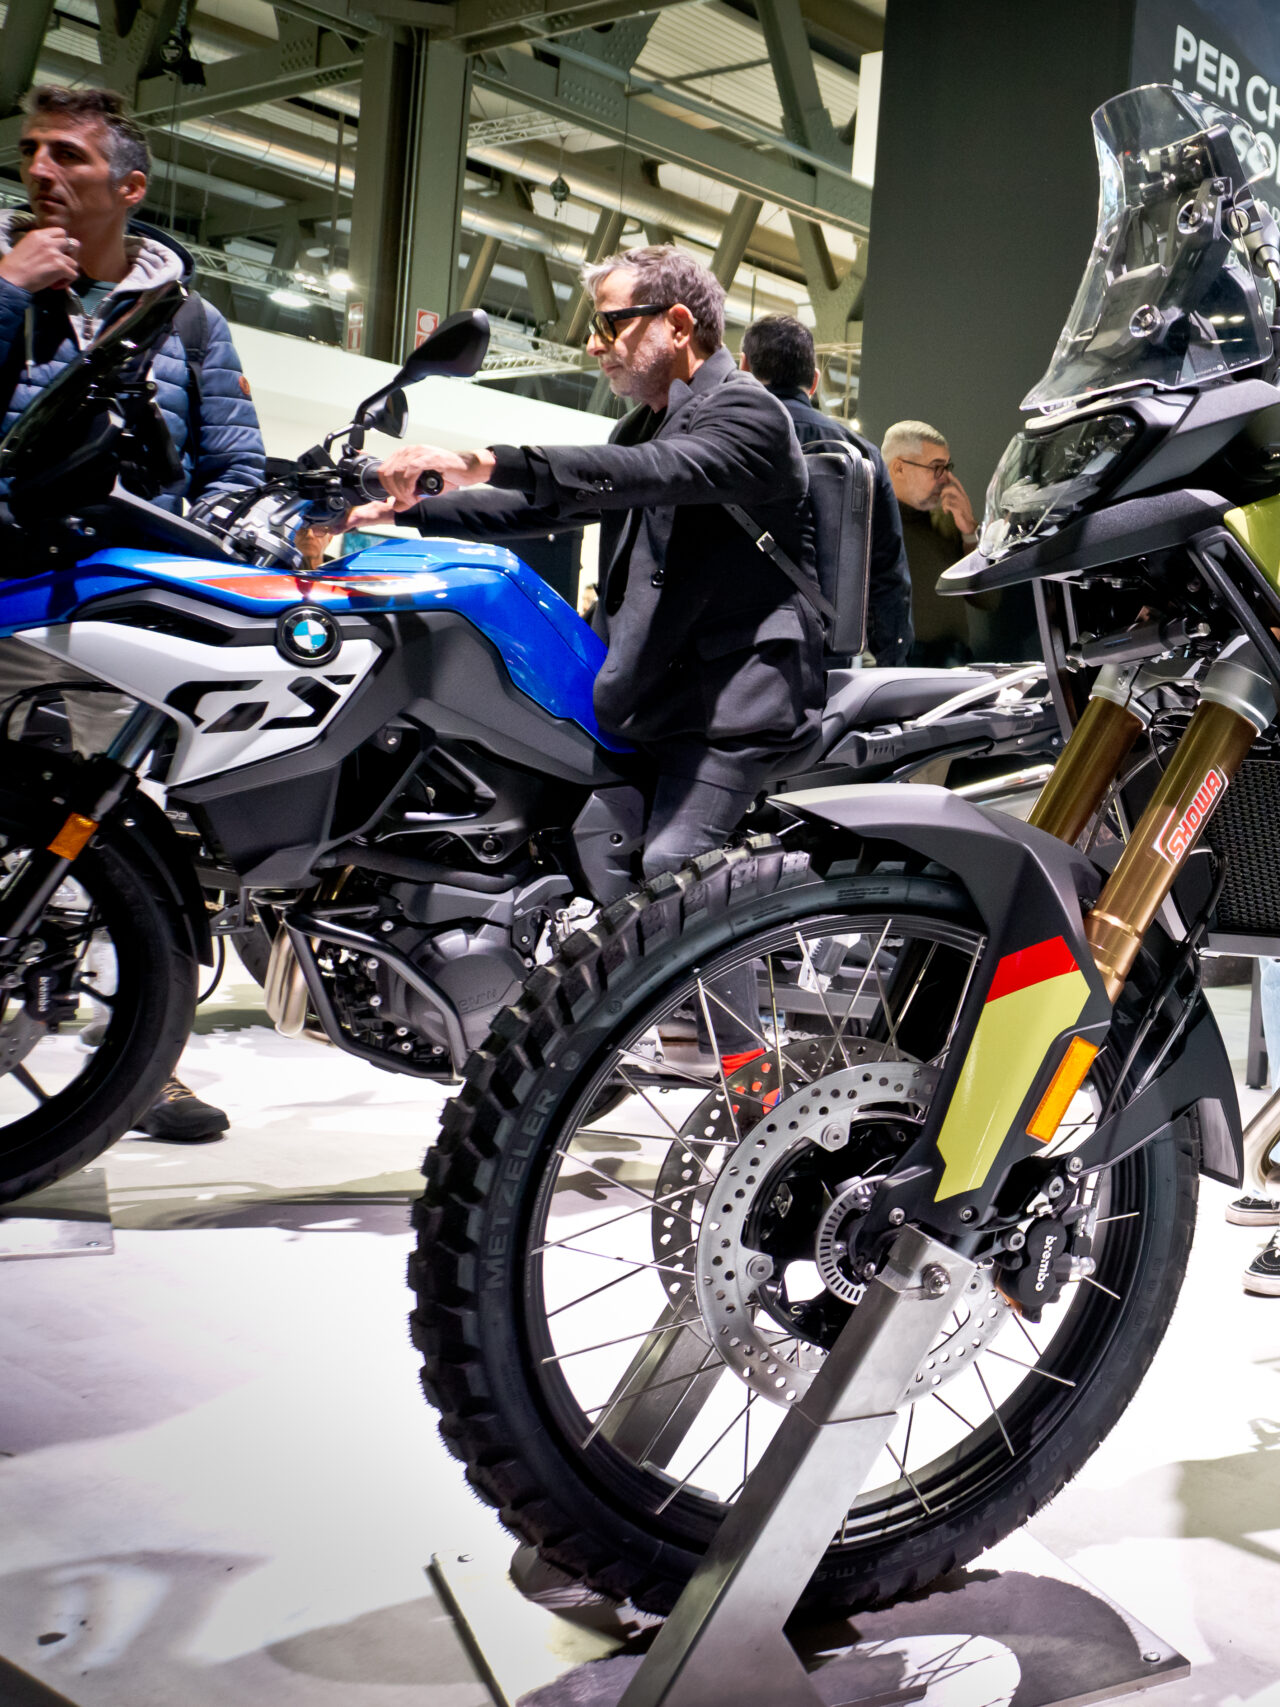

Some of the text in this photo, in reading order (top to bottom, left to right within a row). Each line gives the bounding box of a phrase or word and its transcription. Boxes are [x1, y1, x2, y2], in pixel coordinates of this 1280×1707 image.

[1173, 24, 1240, 107] PER
[1166, 768, 1223, 864] SHOWA
[480, 1088, 559, 1289] METZELER
[1034, 1235, 1058, 1292] brembo
